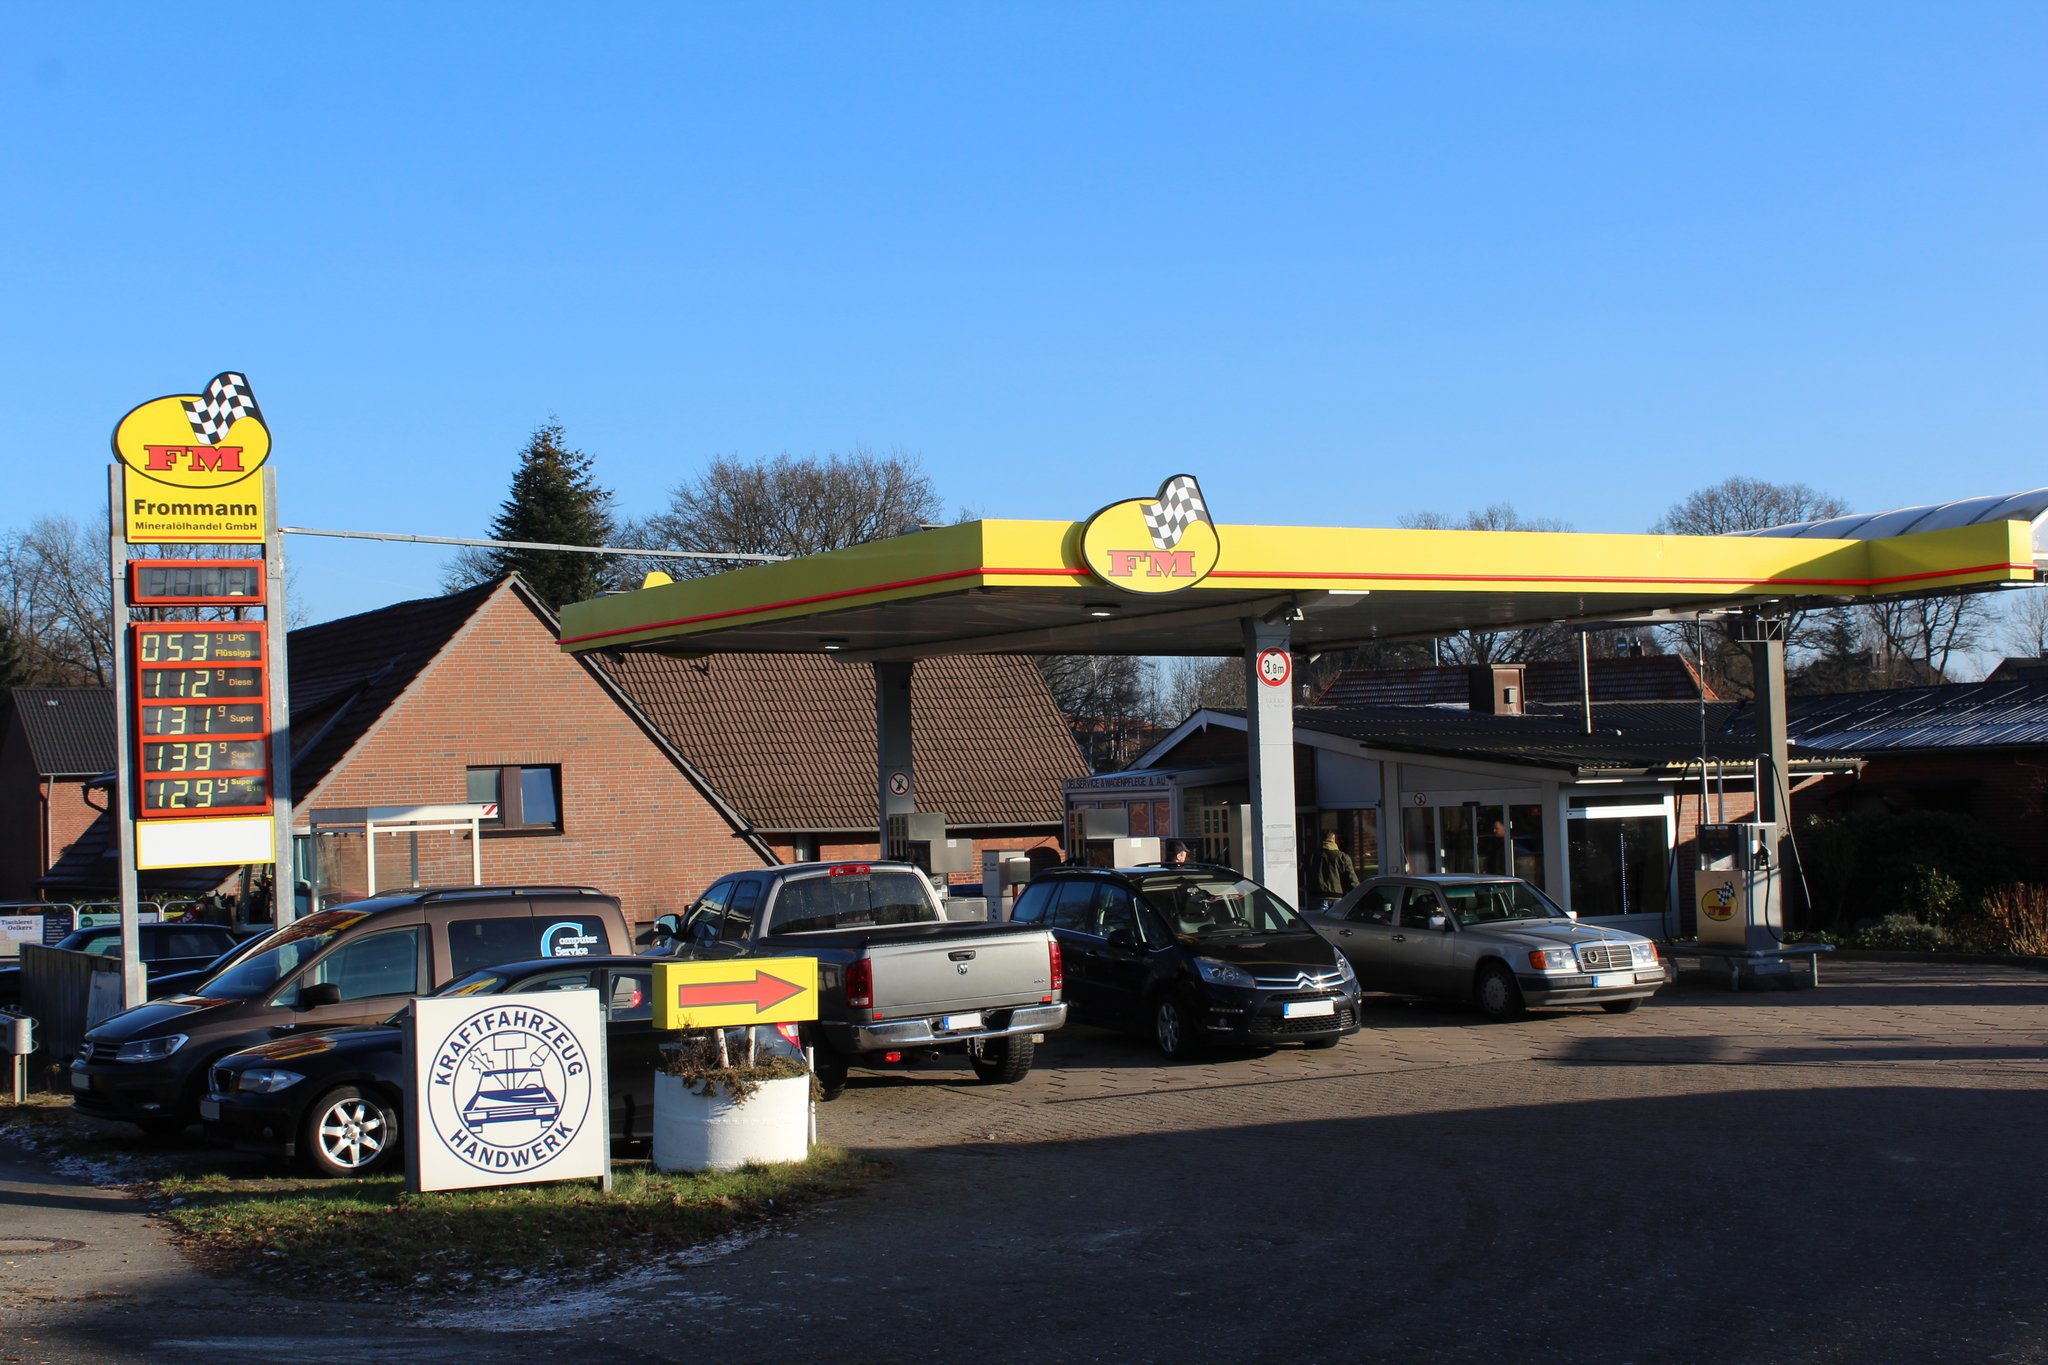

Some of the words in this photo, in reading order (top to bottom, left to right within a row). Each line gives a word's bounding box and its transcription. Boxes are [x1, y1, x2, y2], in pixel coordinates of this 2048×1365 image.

[143, 445, 245, 472] FM
[134, 499, 257, 516] Frommann
[135, 521, 222, 530] Mineralölhandel
[225, 522, 257, 531] GmbH
[1107, 550, 1196, 578] FM
[228, 634, 245, 642] LPG
[230, 714, 254, 723] Super
[434, 1010, 583, 1087] KRAFTFAHRZEUG
[450, 1121, 574, 1169] HANDWERK
